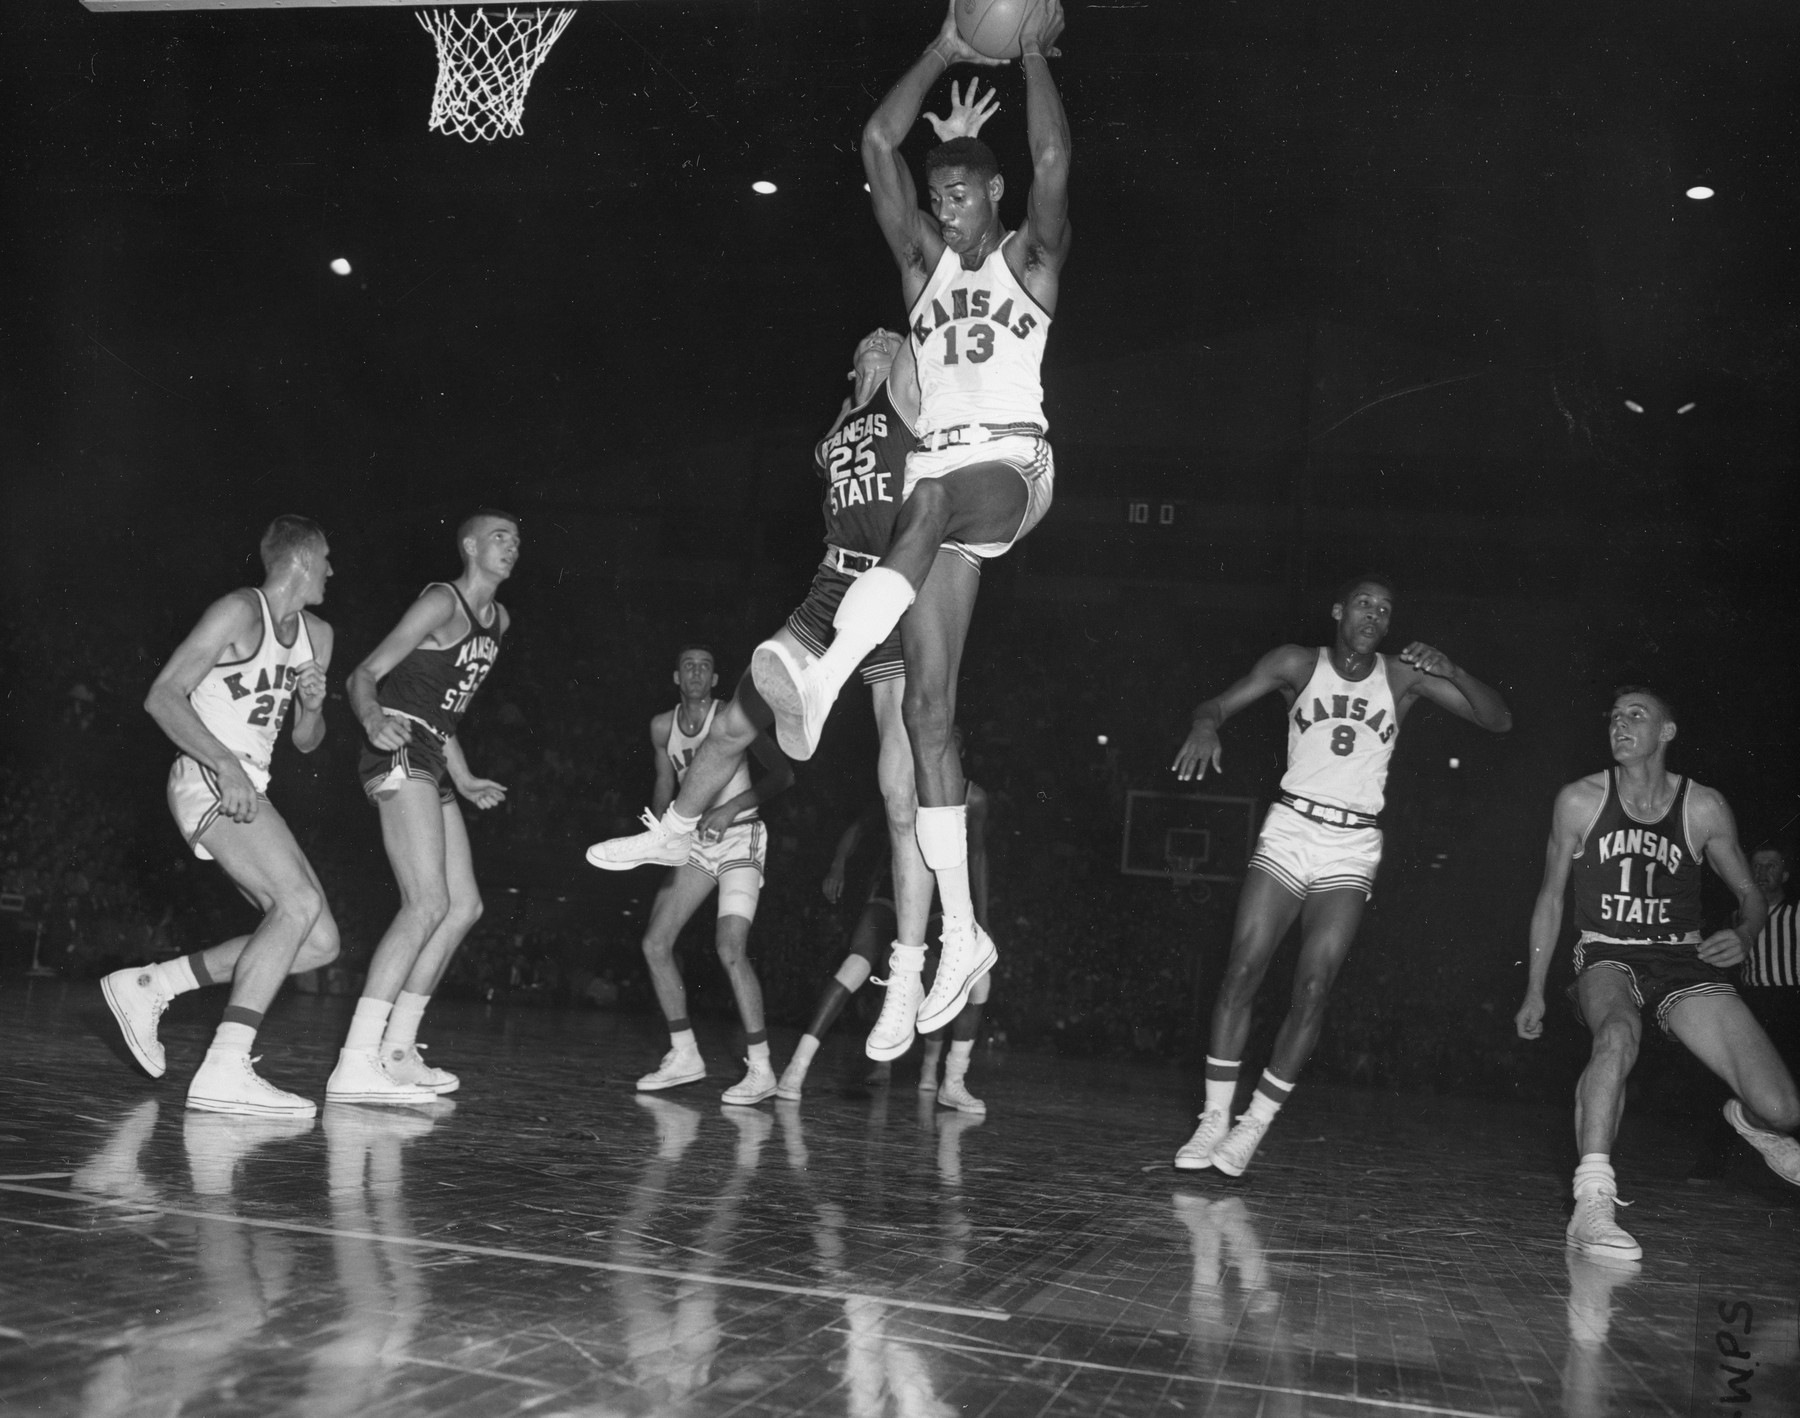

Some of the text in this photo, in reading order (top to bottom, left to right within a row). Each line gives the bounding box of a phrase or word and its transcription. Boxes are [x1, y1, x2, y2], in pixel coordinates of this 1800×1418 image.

[912, 288, 1038, 347] KANSAS
[943, 323, 995, 365] 13
[821, 413, 888, 462] KANSAS
[829, 435, 876, 484] 25
[830, 472, 894, 516] STATE
[223, 664, 297, 701] KANS
[1294, 694, 1395, 745] KANSAS
[1330, 724, 1357, 757] 8
[1599, 828, 1682, 875] KANSAS
[1619, 857, 1657, 897] 11
[1601, 893, 1671, 924] STATE
